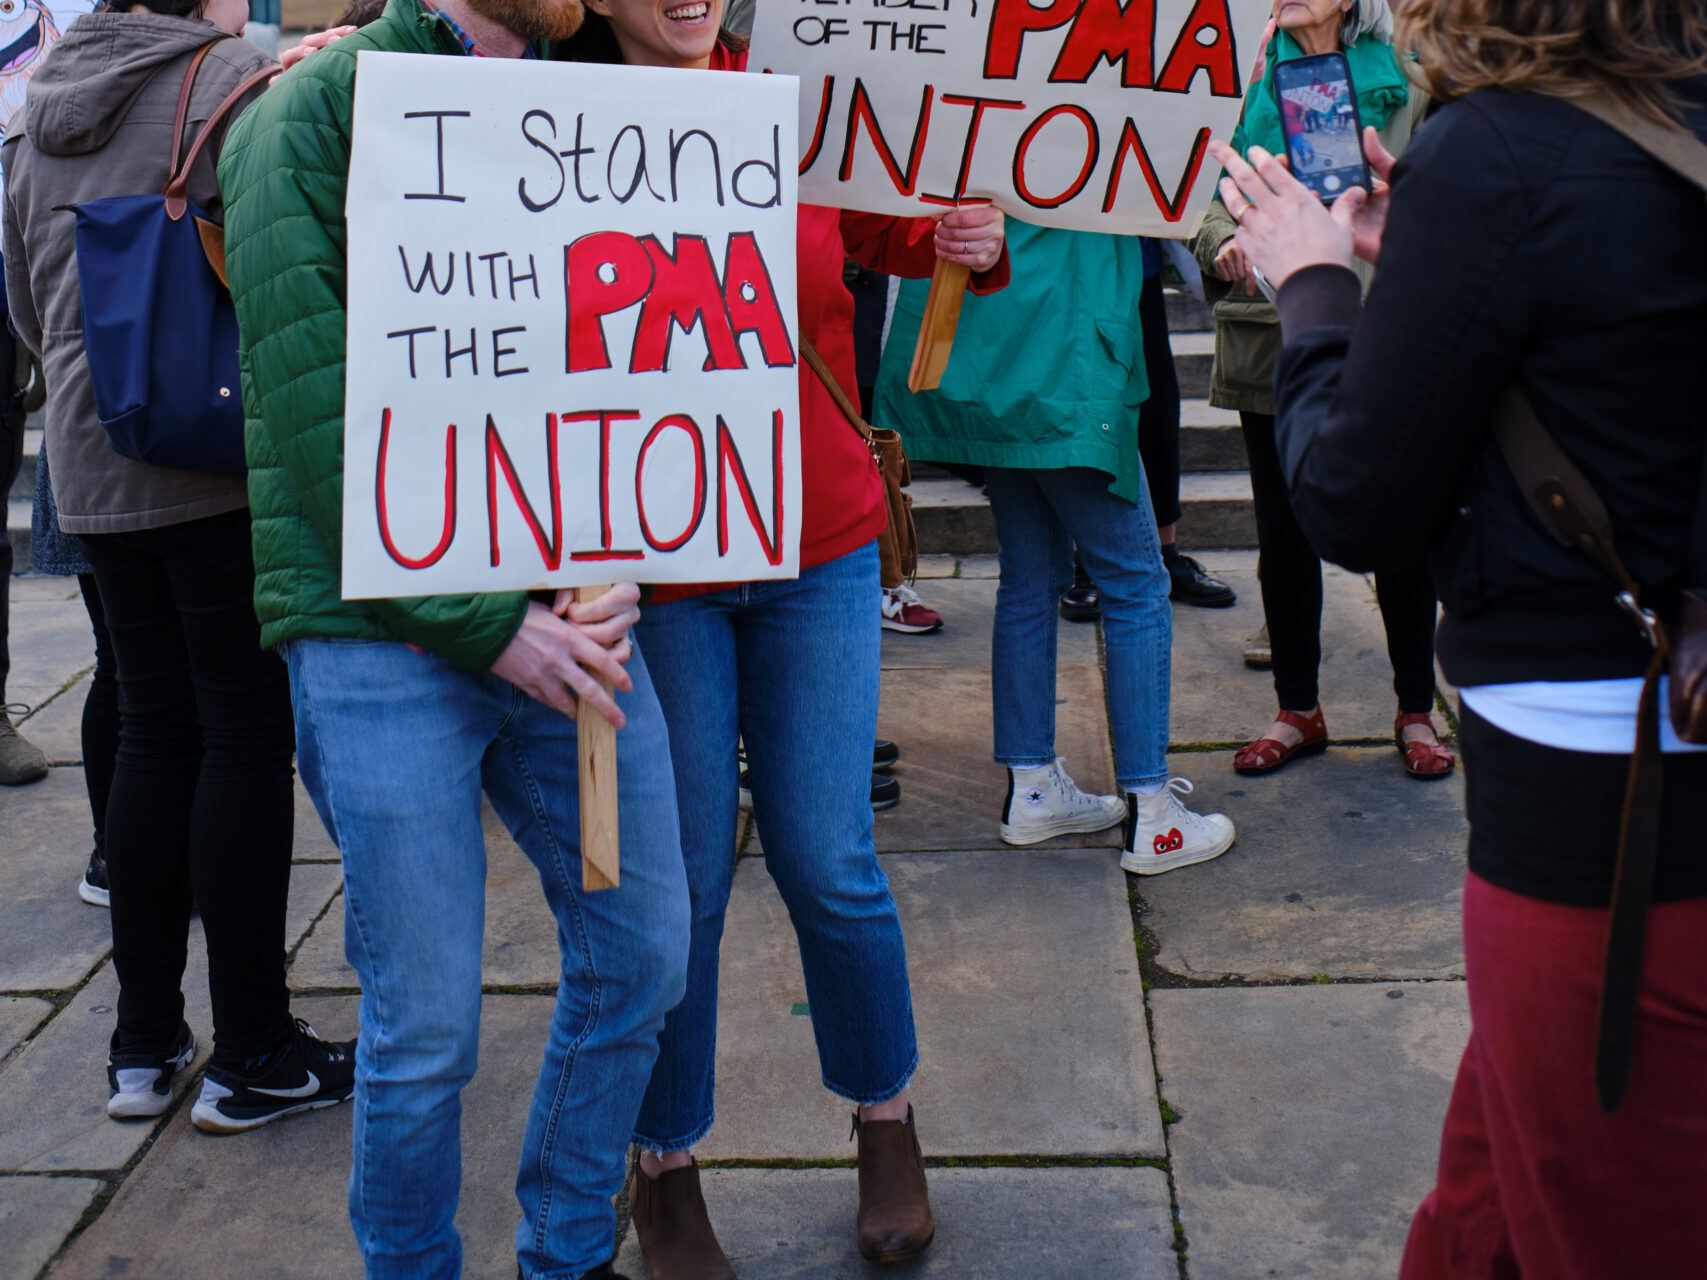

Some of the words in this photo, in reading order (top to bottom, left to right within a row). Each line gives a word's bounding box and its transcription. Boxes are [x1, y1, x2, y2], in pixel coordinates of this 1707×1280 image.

[793, 16, 850, 46] OF
[863, 19, 946, 54] THE
[404, 110, 471, 202] I
[517, 109, 782, 212] Stand
[398, 245, 540, 301] WITH
[564, 230, 796, 374] PMA
[387, 326, 529, 378] THE
[375, 408, 784, 571] UNION
